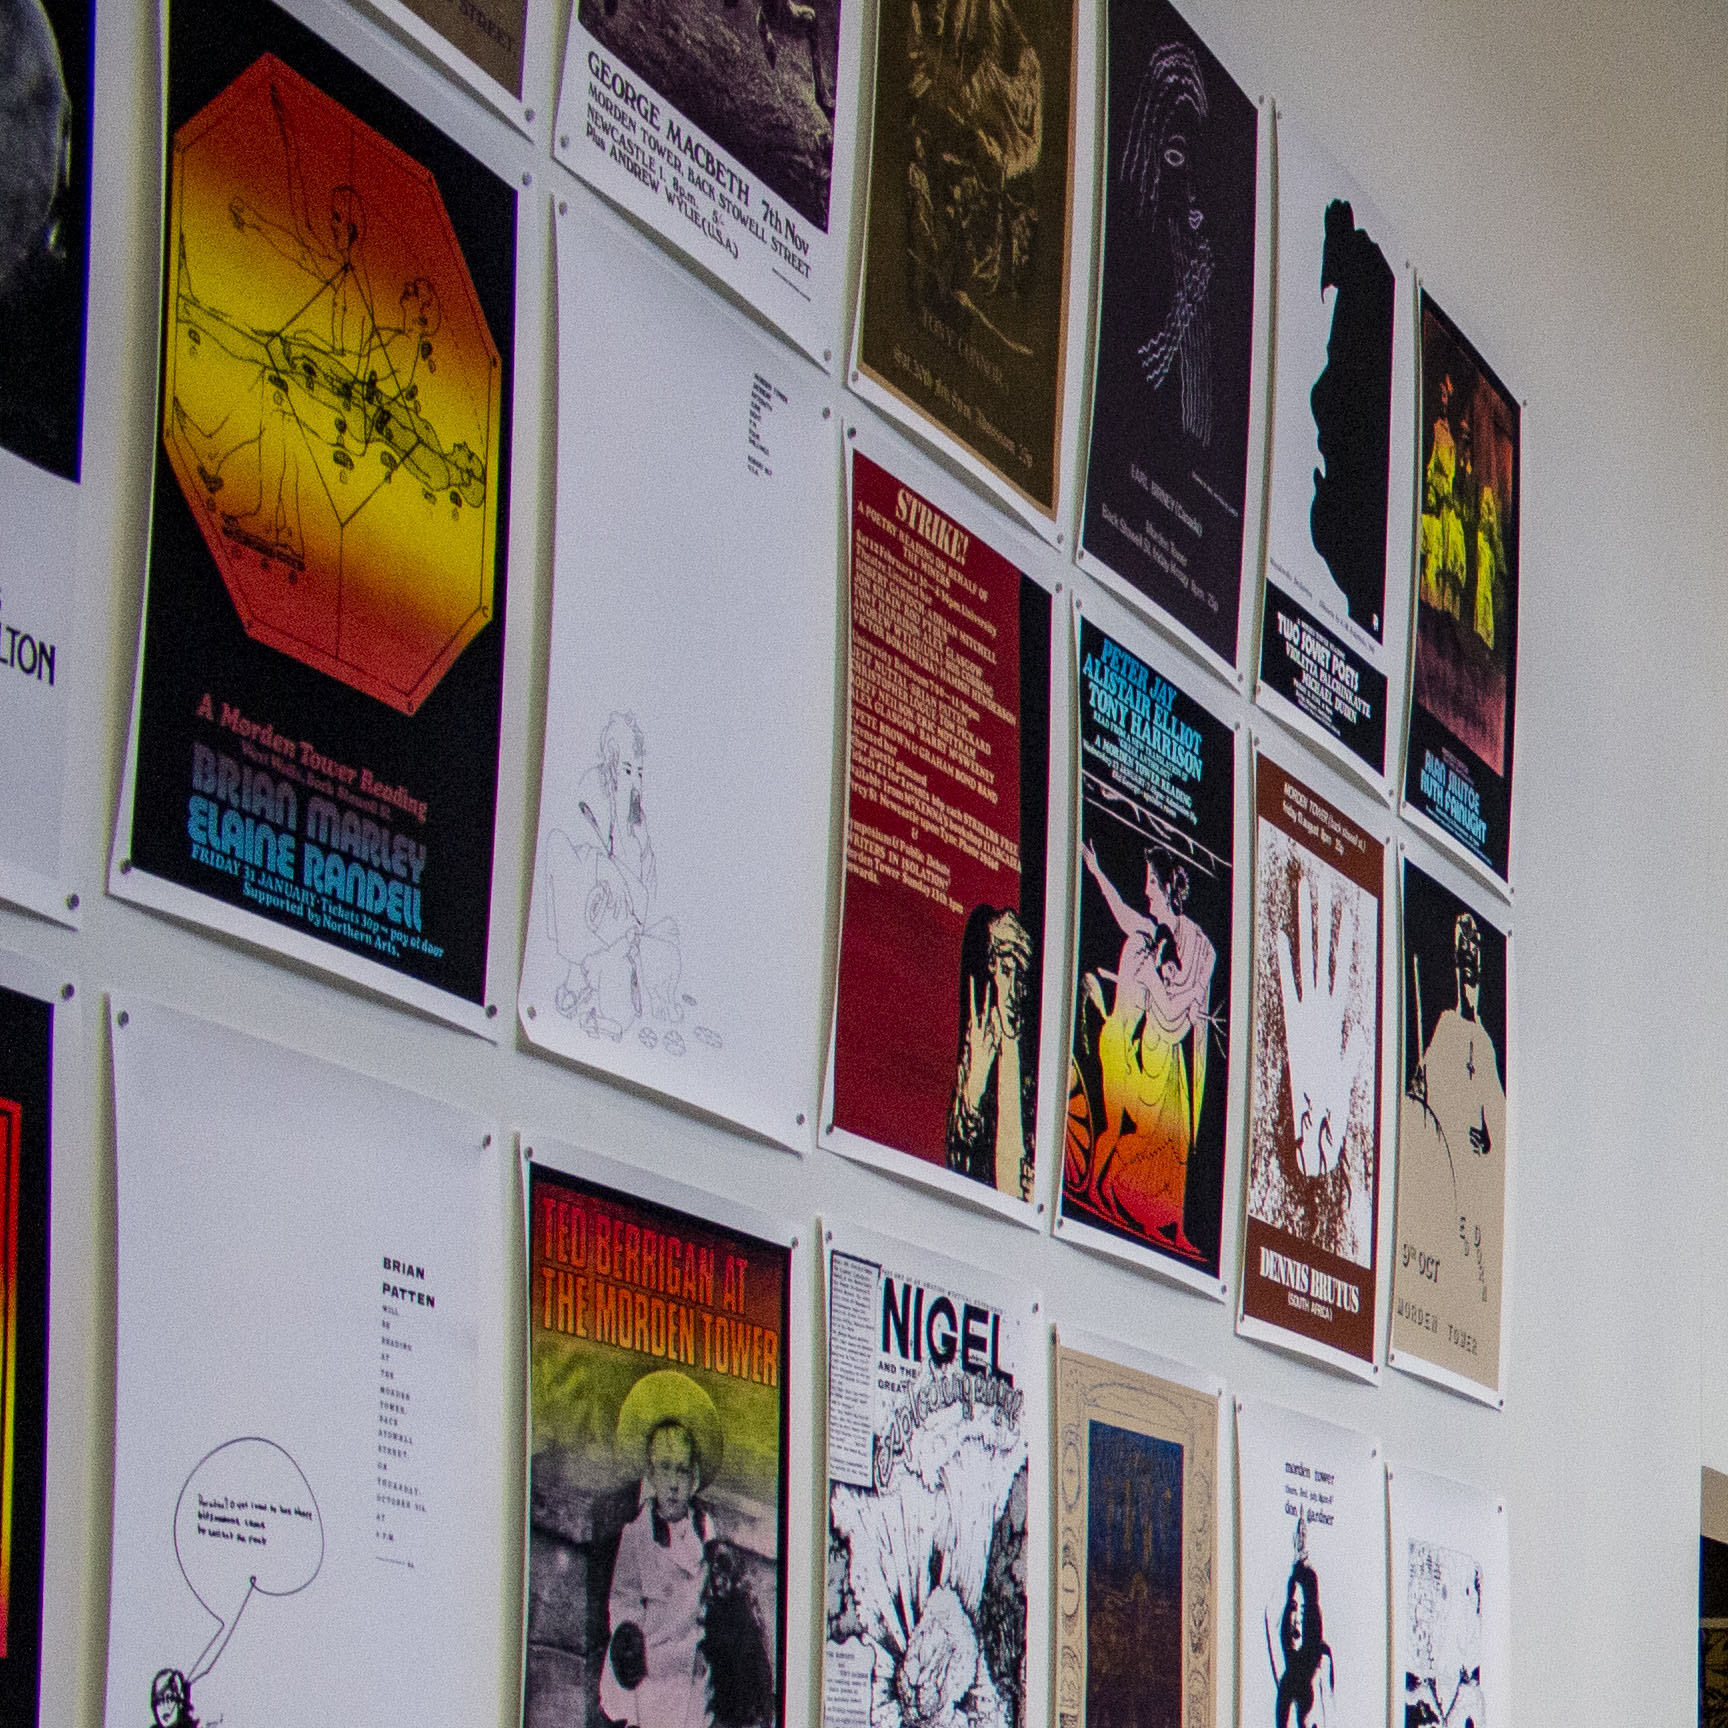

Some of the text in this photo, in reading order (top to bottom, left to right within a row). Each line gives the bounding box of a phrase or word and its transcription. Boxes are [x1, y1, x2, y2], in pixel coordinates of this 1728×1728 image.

[587, 103, 656, 173] NEWCASTLE
[588, 51, 809, 255] GEORGE MACBETH 7th Nov
[610, 145, 660, 192] ANDREW
[589, 82, 811, 279] MORDEN BACK STOWELL STREET
[865, 504, 897, 538] POETRY
[899, 528, 933, 564] READING
[949, 564, 976, 595] BEHALF
[896, 487, 969, 565] STRIKE!
[903, 545, 949, 589] THE MINERS
[1101, 638, 1177, 712] PETER JAY
[1278, 611, 1300, 647] TWO
[1302, 629, 1331, 670] SOVIET
[1332, 653, 1359, 692] POETS
[1083, 652, 1202, 755] ALISTAIR ELLIOT
[1302, 669, 1332, 707] MICHAEL
[196, 693, 428, 823] A Morden Tower Reading
[1088, 681, 1203, 783] TONY HARRISON
[1095, 734, 1192, 809] A MORDEN TOWER READING
[1421, 768, 1444, 808] RUTH
[192, 741, 428, 884] BRIAN MARLEY
[188, 795, 422, 933] ELAINE RANDELL
[191, 843, 241, 877] FRIDAY
[243, 864, 258, 884] 31
[258, 870, 316, 904] JANUARY
[321, 895, 360, 924] Tickets
[390, 927, 408, 948] pay
[410, 934, 420, 949] at
[243, 882, 303, 917] Supported
[307, 908, 320, 927] by
[322, 915, 372, 944] Northern
[382, 1257, 425, 1280] BRIAN
[543, 1197, 748, 1315] TED BERRIGAN AT
[1260, 1246, 1359, 1314] DENNIS BRUTUS
[1418, 1252, 1440, 1283] OCT
[382, 1282, 435, 1308] PATTEN
[382, 1305, 399, 1316] WILL
[541, 1266, 779, 1388] THE MORDEN TOWER
[1398, 1298, 1477, 1355] MORDEN TOWER
[881, 1276, 1014, 1390] NIGEL
[380, 1386, 410, 1401] MORDEN
[878, 1360, 917, 1379] AND THE
[878, 1379, 909, 1394] GREAT
[1285, 1462, 1335, 1485] morden tower
[1285, 1500, 1335, 1526] don gardner
